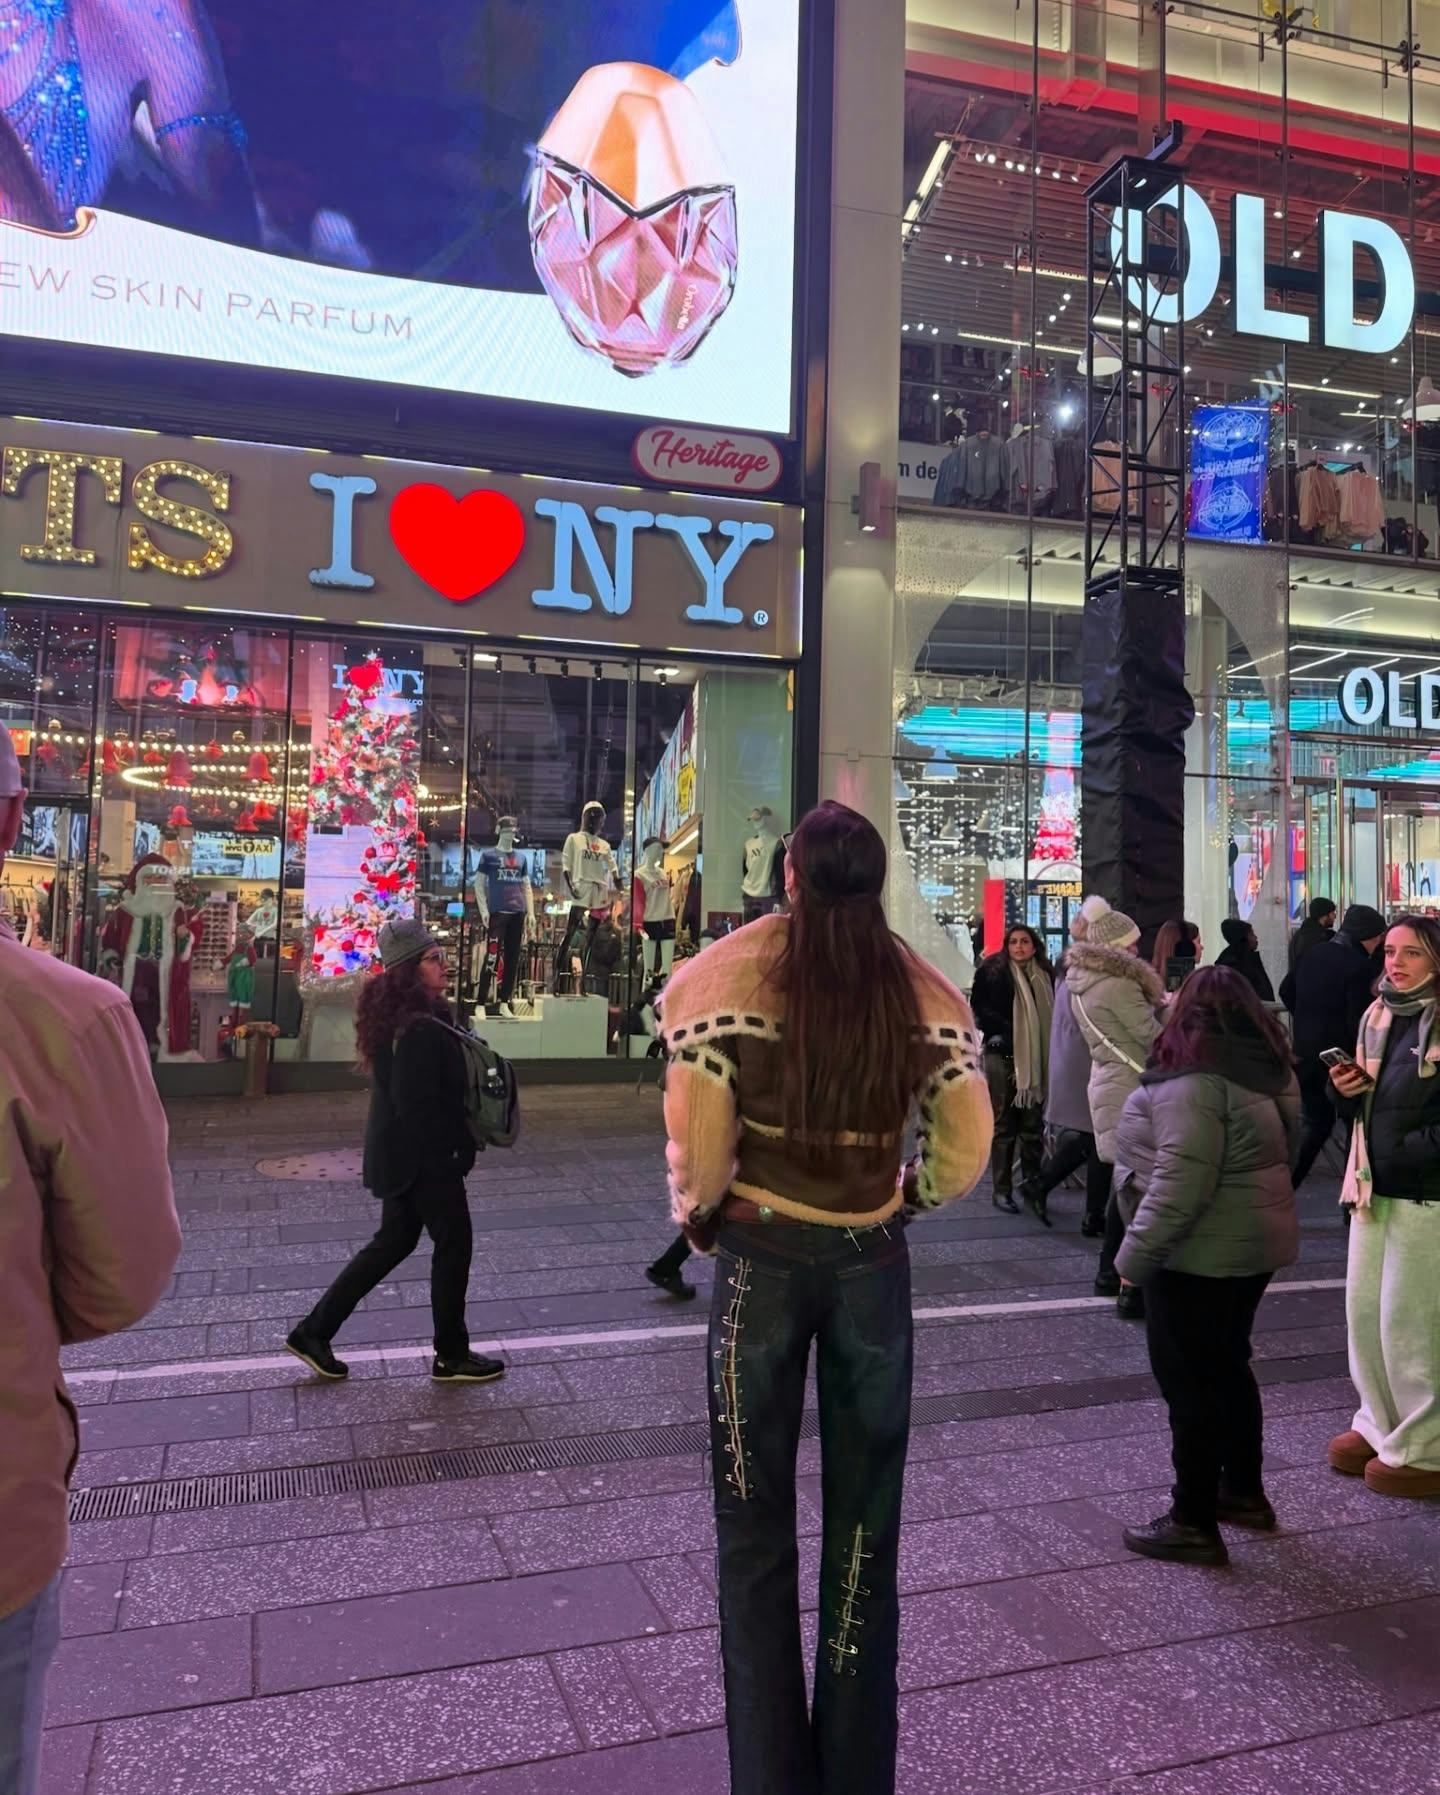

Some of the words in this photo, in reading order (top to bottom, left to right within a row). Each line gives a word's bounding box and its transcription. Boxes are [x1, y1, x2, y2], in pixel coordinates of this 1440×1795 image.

[91, 274, 204, 313] SKIN
[226, 292, 412, 340] PARFUM
[1109, 184, 1415, 354] OLD
[2, 446, 233, 580] TS
[651, 429, 770, 484] Heritage
[308, 472, 377, 589] I
